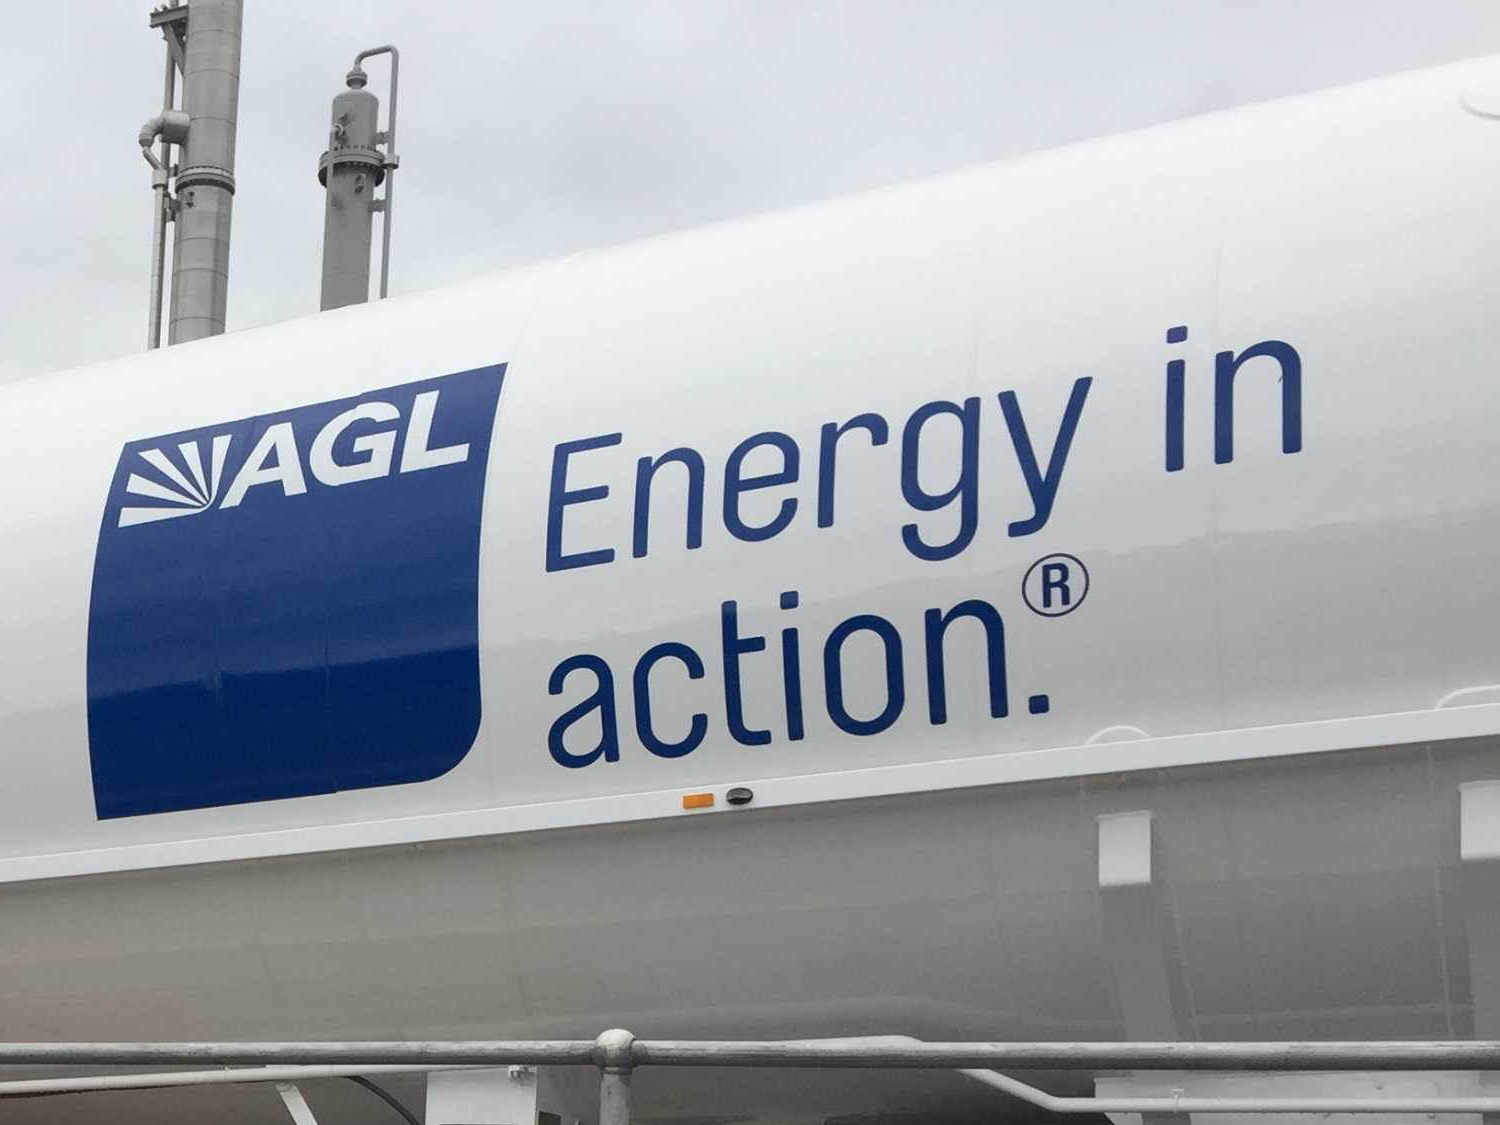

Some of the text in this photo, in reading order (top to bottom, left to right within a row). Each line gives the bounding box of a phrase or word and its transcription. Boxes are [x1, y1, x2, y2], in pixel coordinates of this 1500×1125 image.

[219, 389, 470, 509] AGL
[545, 326, 1302, 573] Energy in
